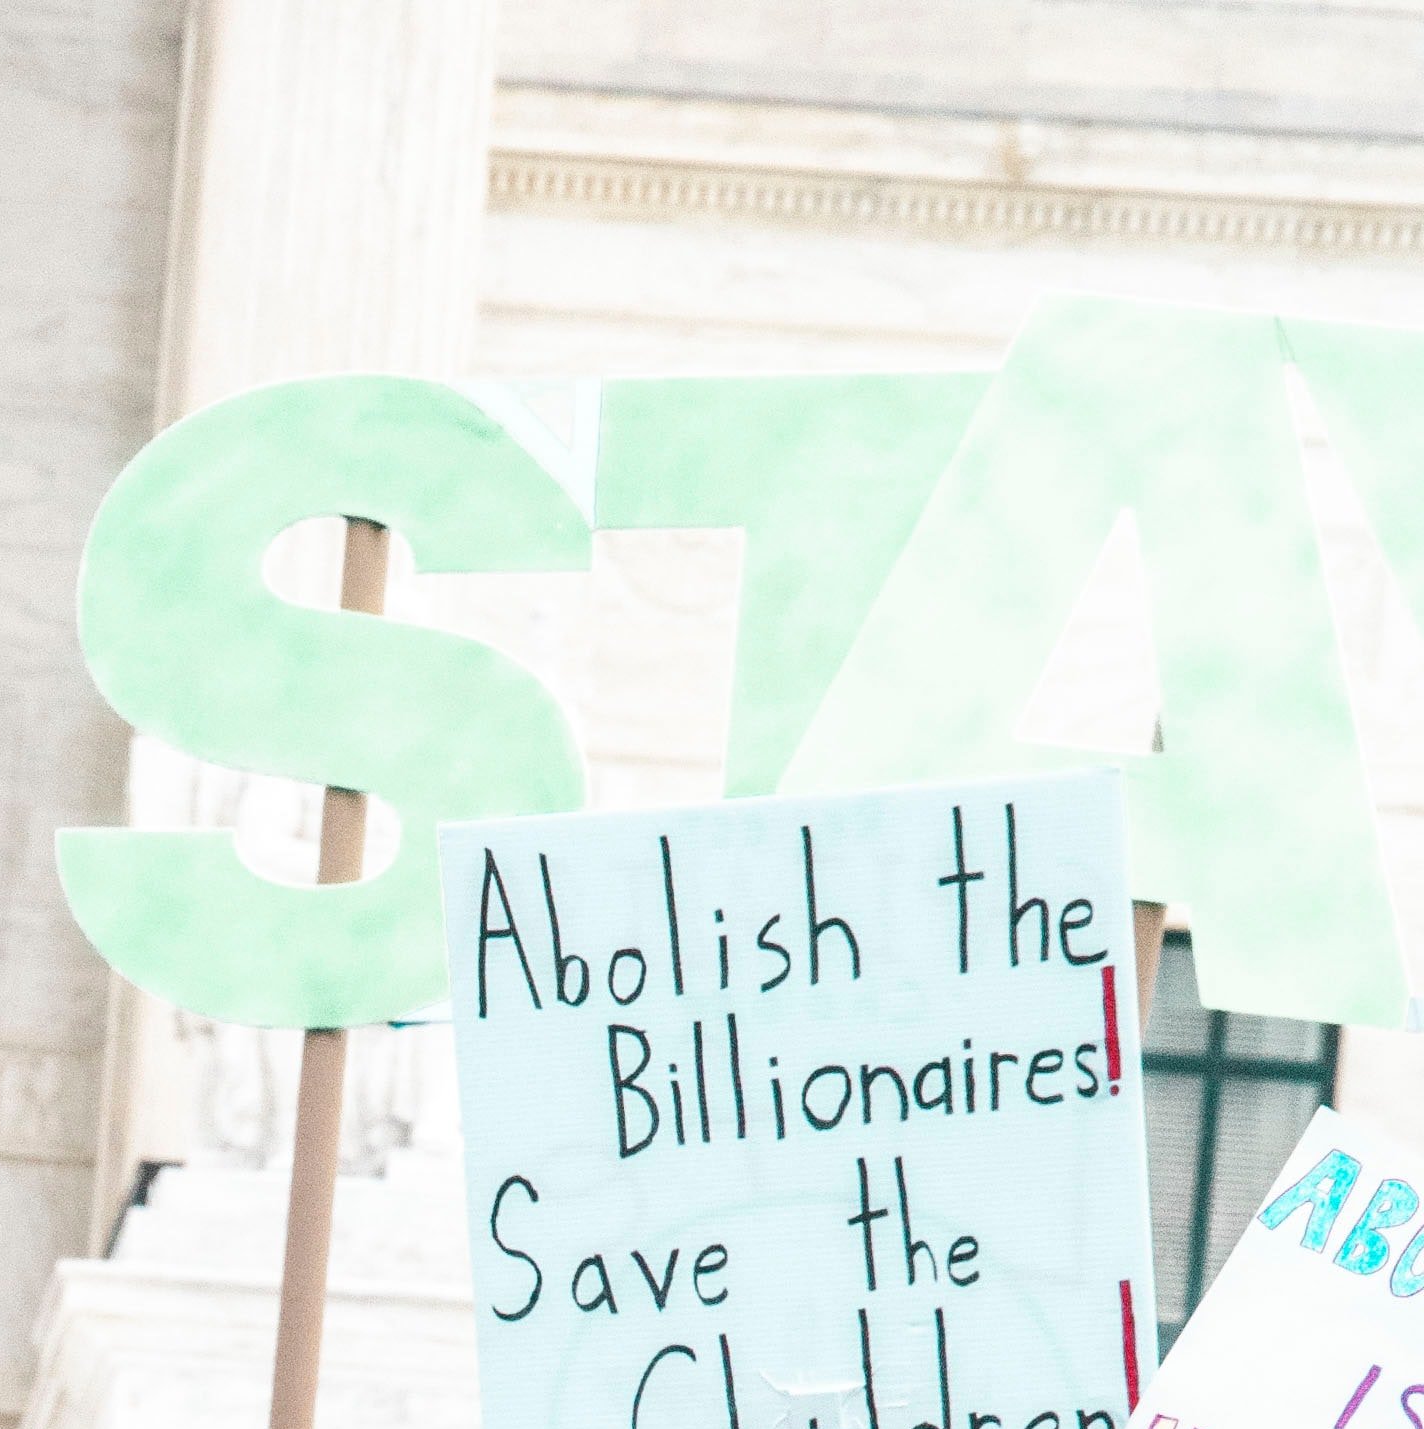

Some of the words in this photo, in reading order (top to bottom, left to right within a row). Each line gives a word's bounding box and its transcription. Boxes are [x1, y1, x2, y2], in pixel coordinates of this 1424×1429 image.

[56, 292, 1424, 1030] STA
[477, 825, 861, 1019] Abolish
[939, 802, 1109, 974] the
[608, 965, 1124, 1158] Billionaires!
[490, 1174, 730, 1322] Save
[847, 1155, 982, 1291] the
